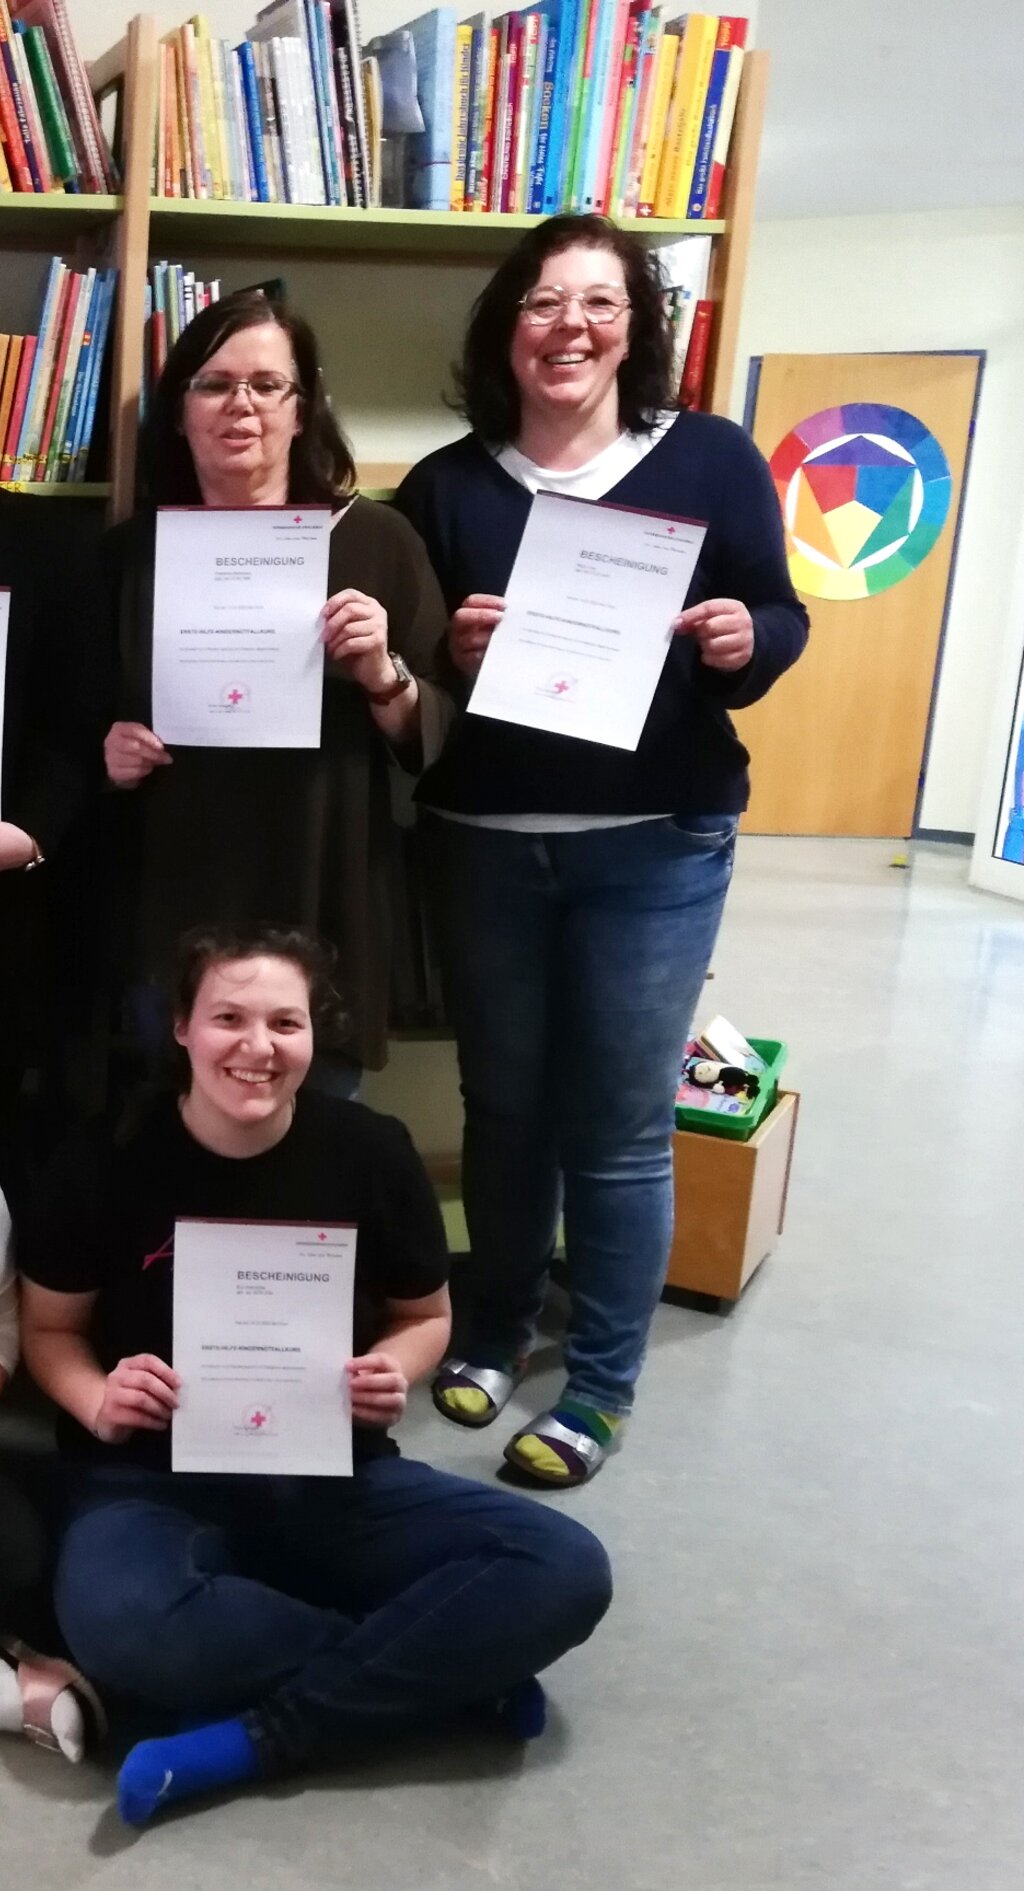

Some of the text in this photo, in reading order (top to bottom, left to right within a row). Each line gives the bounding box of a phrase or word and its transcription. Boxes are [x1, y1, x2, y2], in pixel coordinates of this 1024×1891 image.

[215, 556, 305, 567] BESCHEINIGUNG
[579, 549, 669, 576] BESCHEINIGUNG
[237, 1270, 330, 1283] BESCHEINIGUNG
